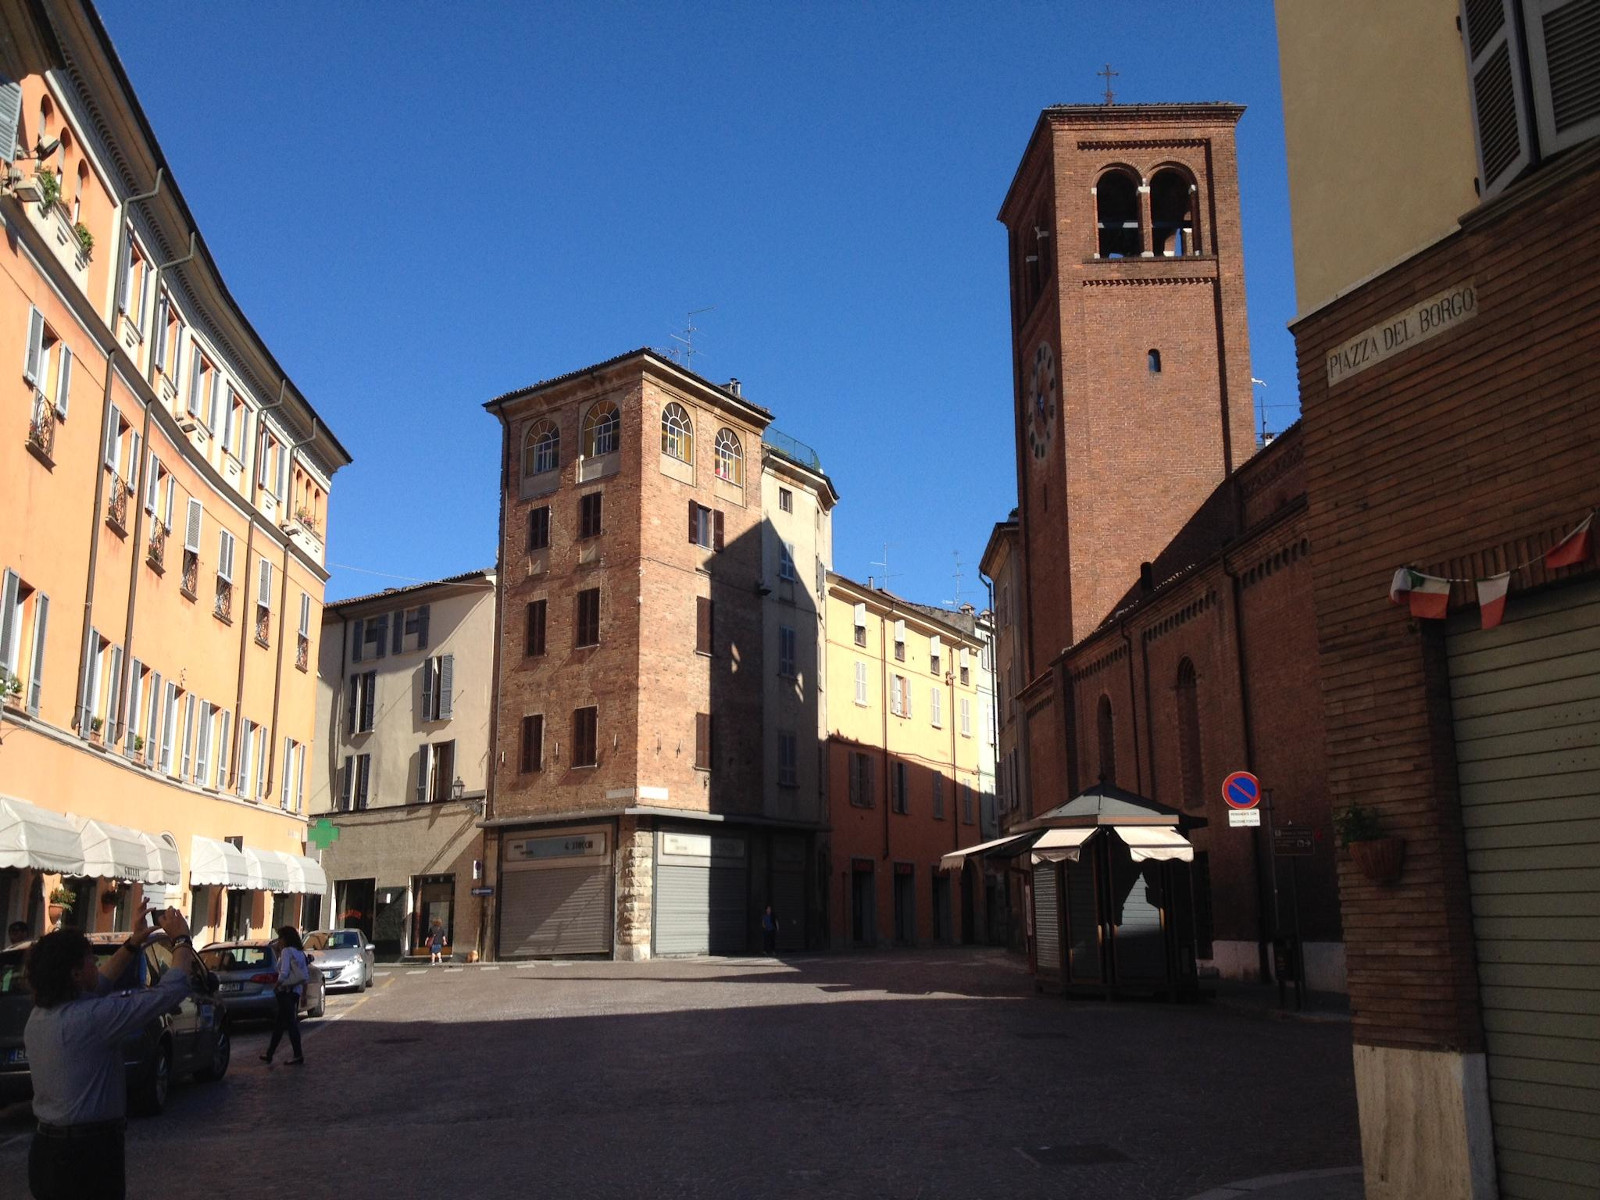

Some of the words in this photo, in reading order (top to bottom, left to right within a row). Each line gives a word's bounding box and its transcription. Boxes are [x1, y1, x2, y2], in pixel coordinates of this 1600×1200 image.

[1329, 336, 1380, 378] PIAZZA
[1383, 319, 1415, 351] DEL
[1418, 287, 1474, 333] BORGO
